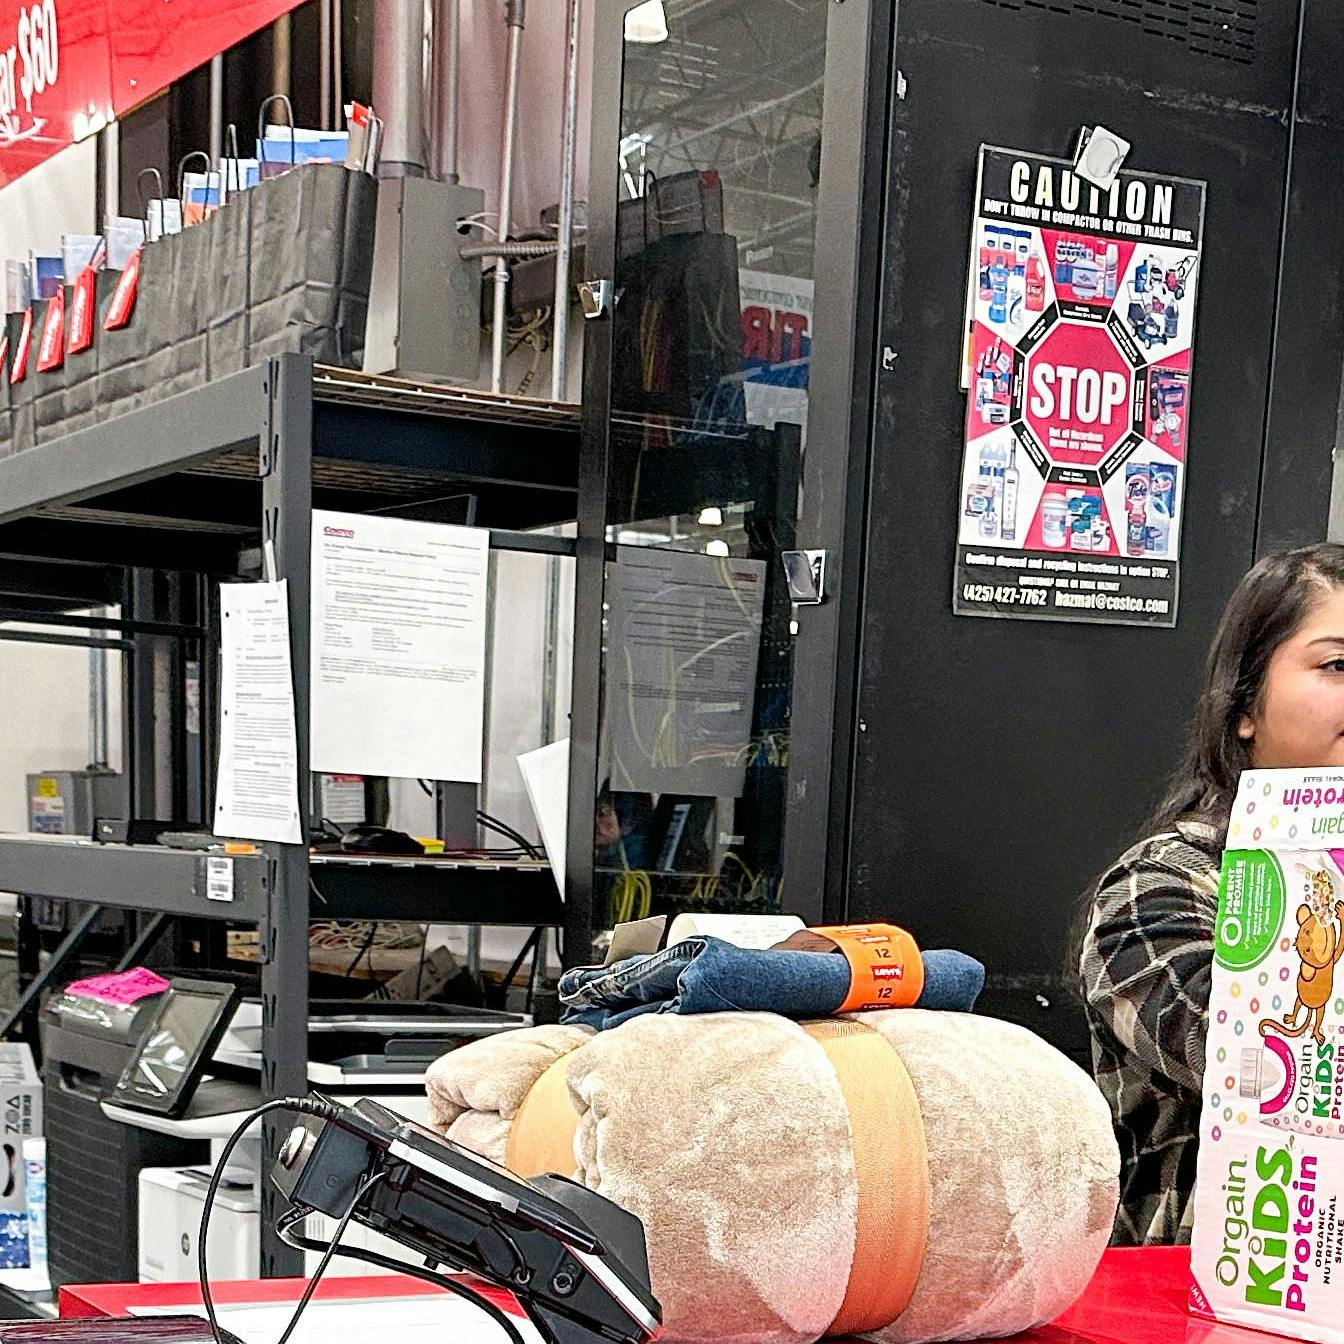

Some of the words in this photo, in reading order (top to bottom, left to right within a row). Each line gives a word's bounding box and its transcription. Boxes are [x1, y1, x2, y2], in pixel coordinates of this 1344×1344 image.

[17, 0, 59, 112] $60
[1010, 202, 1040, 220] THROW
[1052, 210, 1101, 230] COMPACTOR
[1102, 218, 1115, 232] OR
[1115, 221, 1142, 236] OTHER
[1144, 224, 1171, 240] TRASH
[1030, 362, 1127, 425] STOP
[1054, 590, 1169, 614] hazmat@costco.com
[1225, 867, 1235, 915] PARENT
[874, 948, 892, 959] 12
[877, 987, 893, 999] 12
[1295, 1042, 1314, 1114] Orgain
[1216, 1160, 1249, 1287] Orgain
[1286, 1155, 1318, 1312] Protein
[1315, 1208, 1326, 1268] ORGANIC
[1323, 1195, 1337, 1285] NUTRITIONAL
[1335, 1219, 1344, 1264] SHAKE
